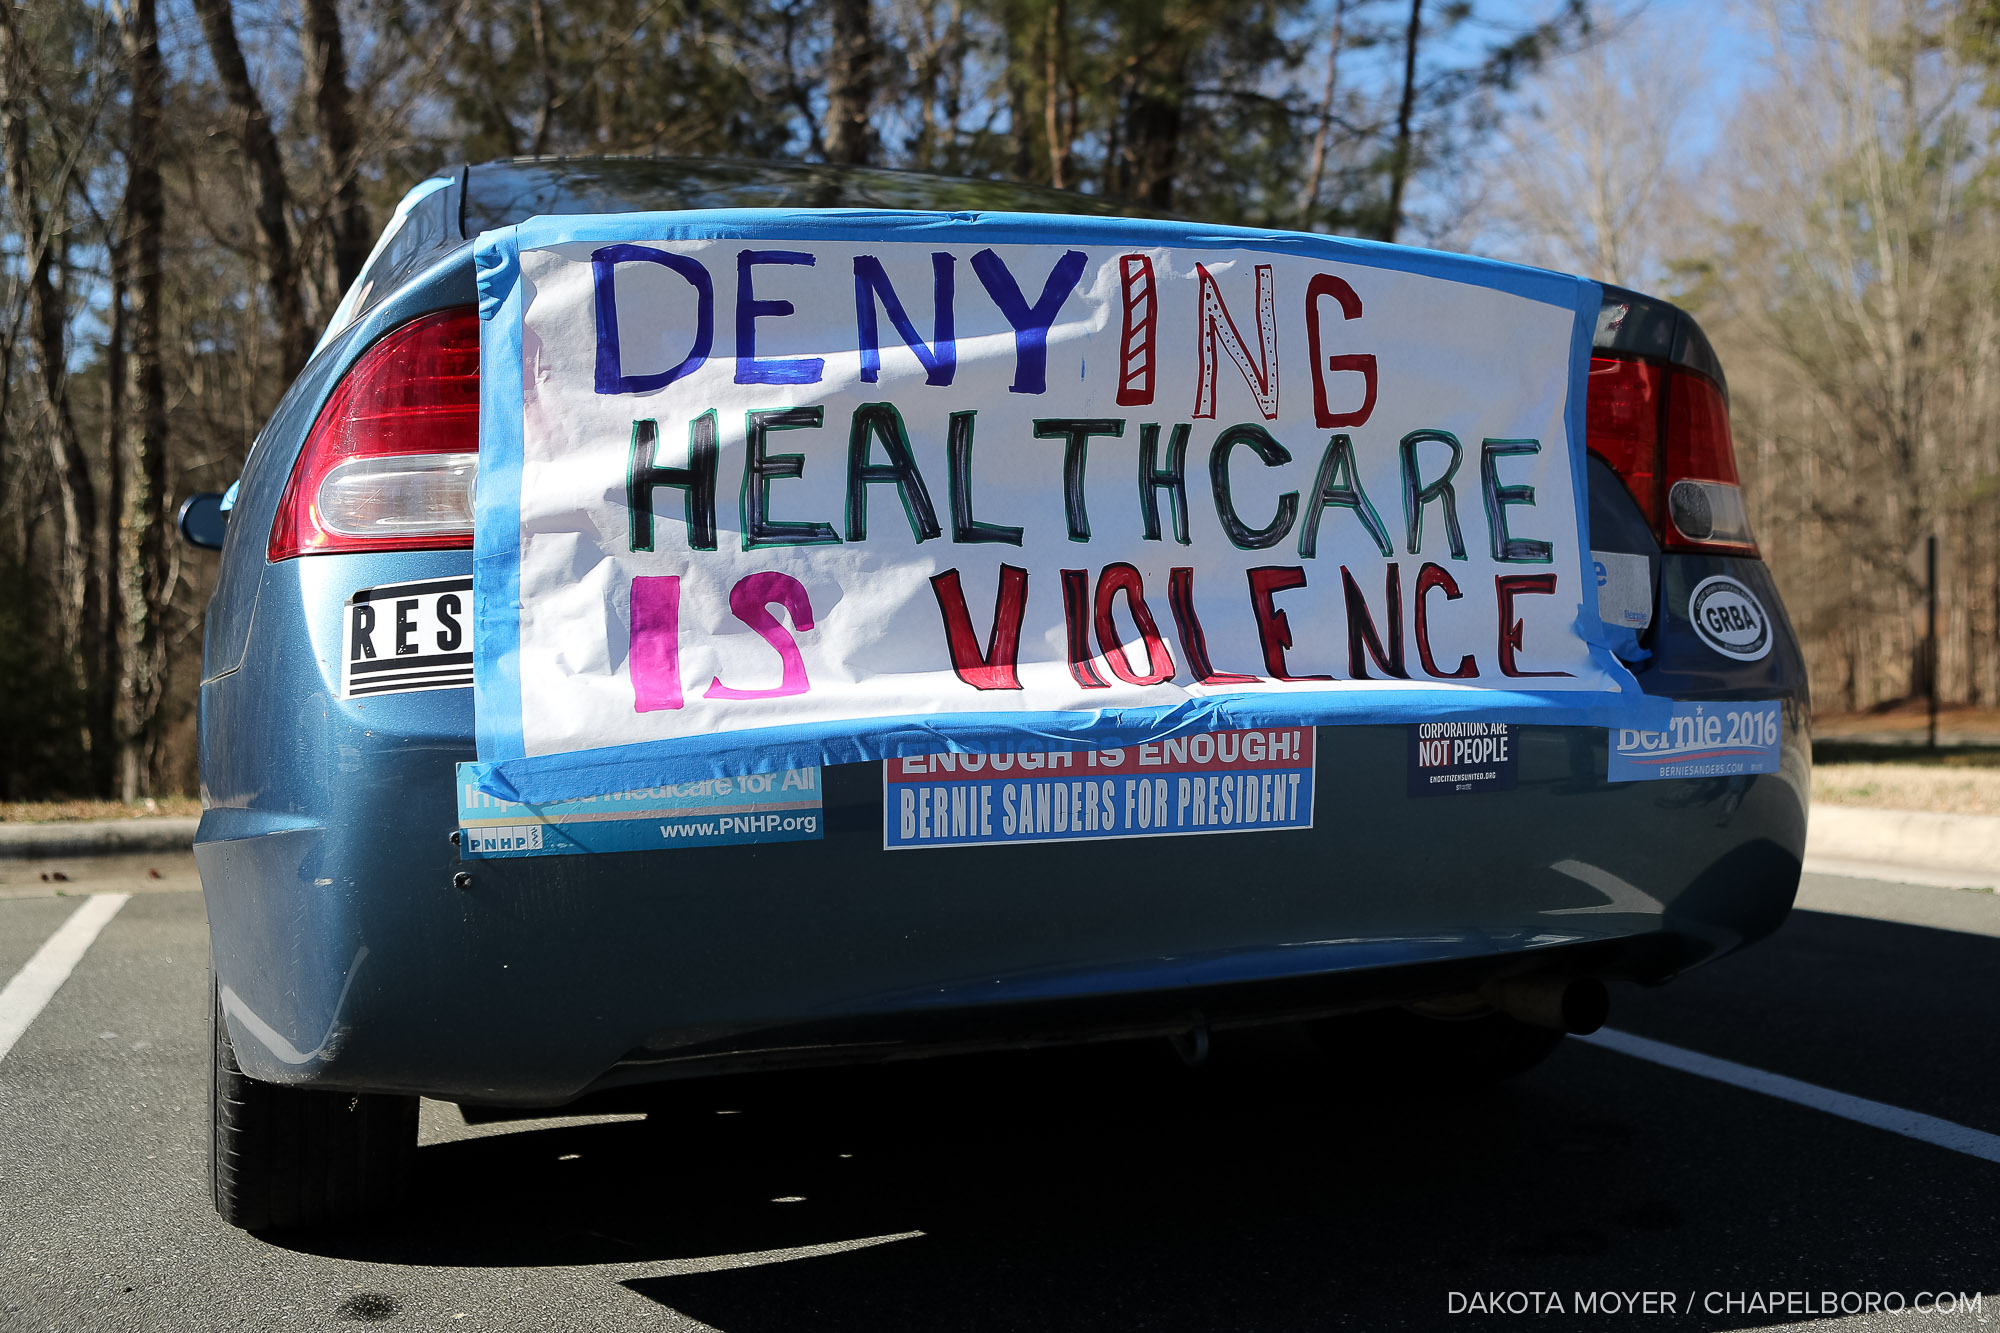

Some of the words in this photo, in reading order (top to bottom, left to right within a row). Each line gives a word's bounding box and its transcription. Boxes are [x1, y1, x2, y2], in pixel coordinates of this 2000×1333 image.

[591, 244, 1378, 428] DENYING
[626, 402, 1554, 563] HEALTHCARE
[351, 593, 462, 661] RES
[1706, 604, 1758, 634] GRBA
[629, 571, 815, 713] IS
[929, 562, 1578, 691] VIOLENCE
[1419, 722, 1489, 739] CORPORATIONS
[1490, 723, 1508, 736] ARE
[1726, 709, 1778, 747] 2016
[1138, 730, 1301, 766] ENOUGH!
[1419, 740, 1451, 767] NOT
[1454, 736, 1508, 765] PEOPLE
[781, 766, 815, 792] All
[1659, 763, 1744, 777] BERNIESANDERS.COM
[900, 785, 992, 840] BERNIE
[1002, 779, 1116, 836] SANDERS
[1124, 778, 1169, 829] FOR
[1177, 773, 1301, 827] PRESIDENT
[660, 814, 818, 839] www.PNHP.org
[471, 837, 526, 851] PNHP
